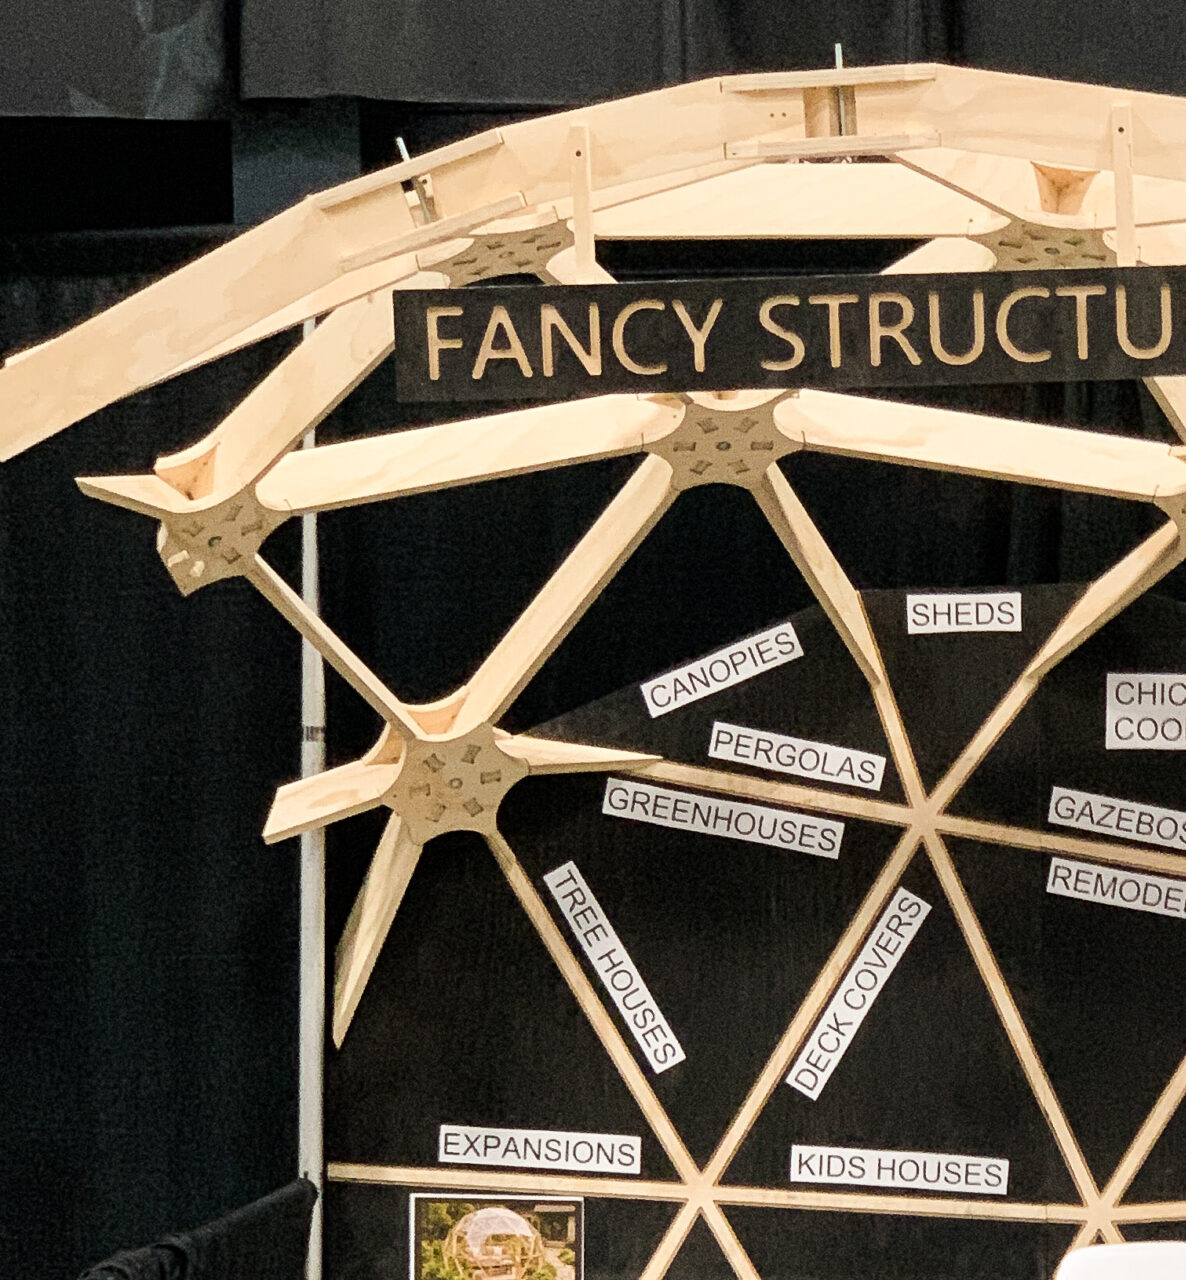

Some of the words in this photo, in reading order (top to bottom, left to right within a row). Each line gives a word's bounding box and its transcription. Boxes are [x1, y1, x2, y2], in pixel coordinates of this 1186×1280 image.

[426, 298, 723, 381] FANCY
[911, 601, 1016, 627] SHEDS
[649, 631, 796, 708] CANOPIES
[713, 730, 877, 784] PERGOLAS
[607, 786, 837, 852] GREENHOUSES
[554, 869, 607, 948] TREE
[598, 946, 677, 1065] HOUSES
[794, 1017, 854, 1092] DECK
[843, 896, 923, 1018] COVERS
[443, 1132, 636, 1167] EXPANSIONS
[798, 1152, 866, 1179] KIDS
[877, 1158, 1003, 1188] HOUSES
